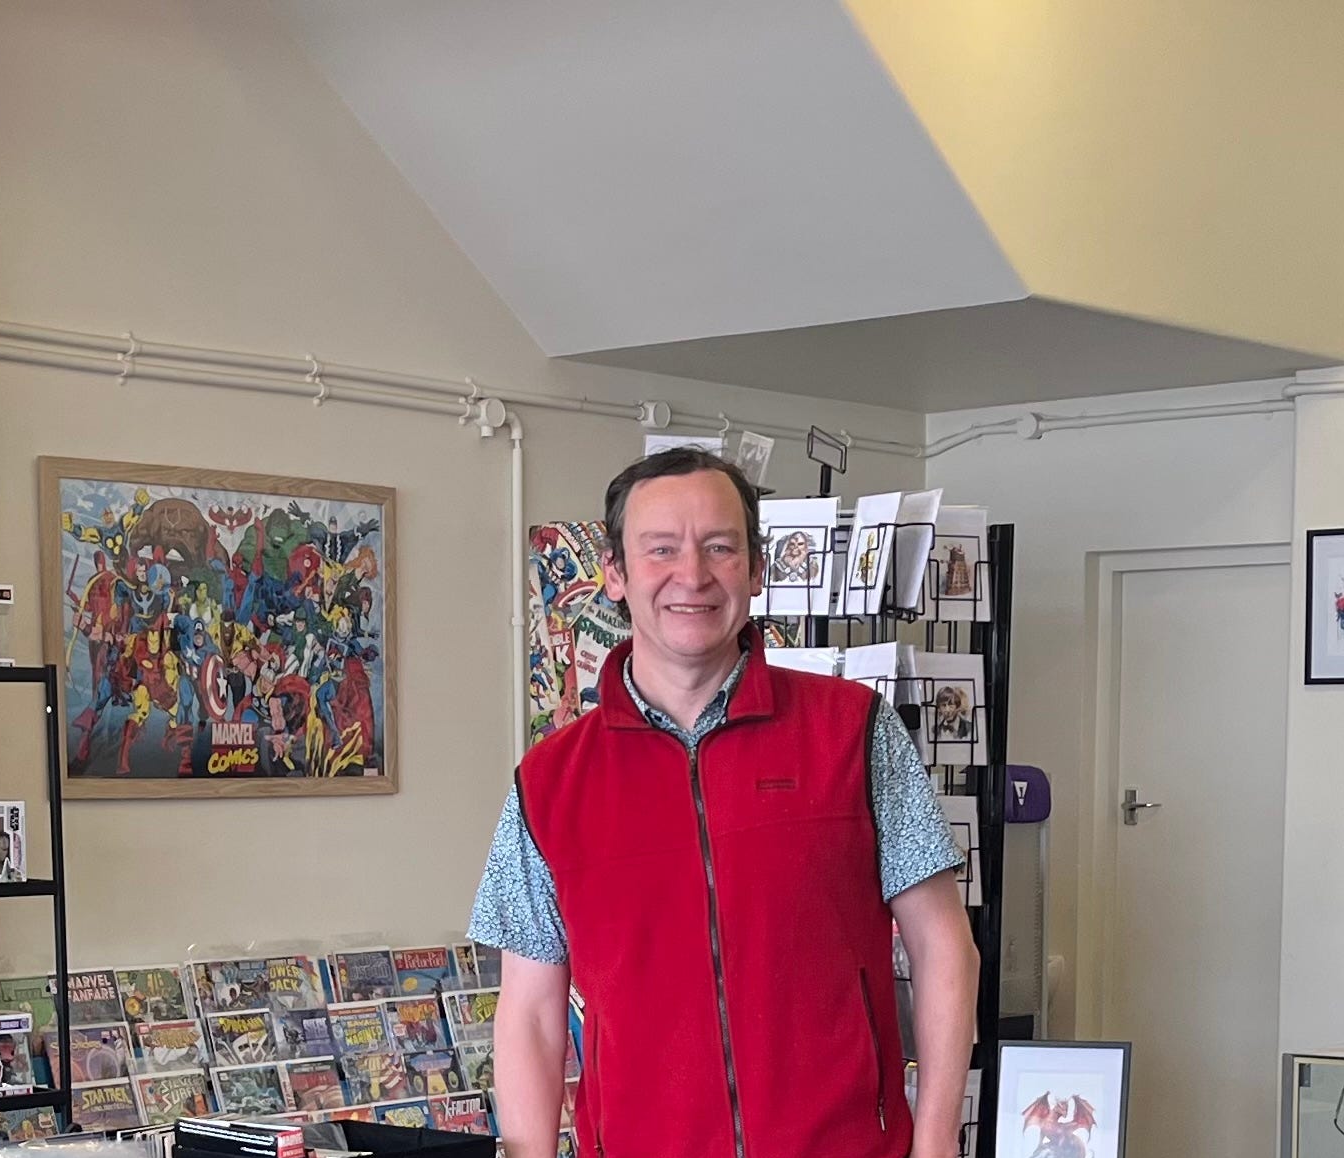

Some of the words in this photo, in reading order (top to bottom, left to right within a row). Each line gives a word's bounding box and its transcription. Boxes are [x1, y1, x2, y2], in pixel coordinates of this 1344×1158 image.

[578, 615, 633, 649] SPIDER-MA
[211, 723, 256, 746] MARVEL
[208, 748, 259, 773] COMICS
[268, 964, 300, 977] OWER
[68, 974, 112, 989] MARVEL
[68, 986, 117, 1003] FANFARE
